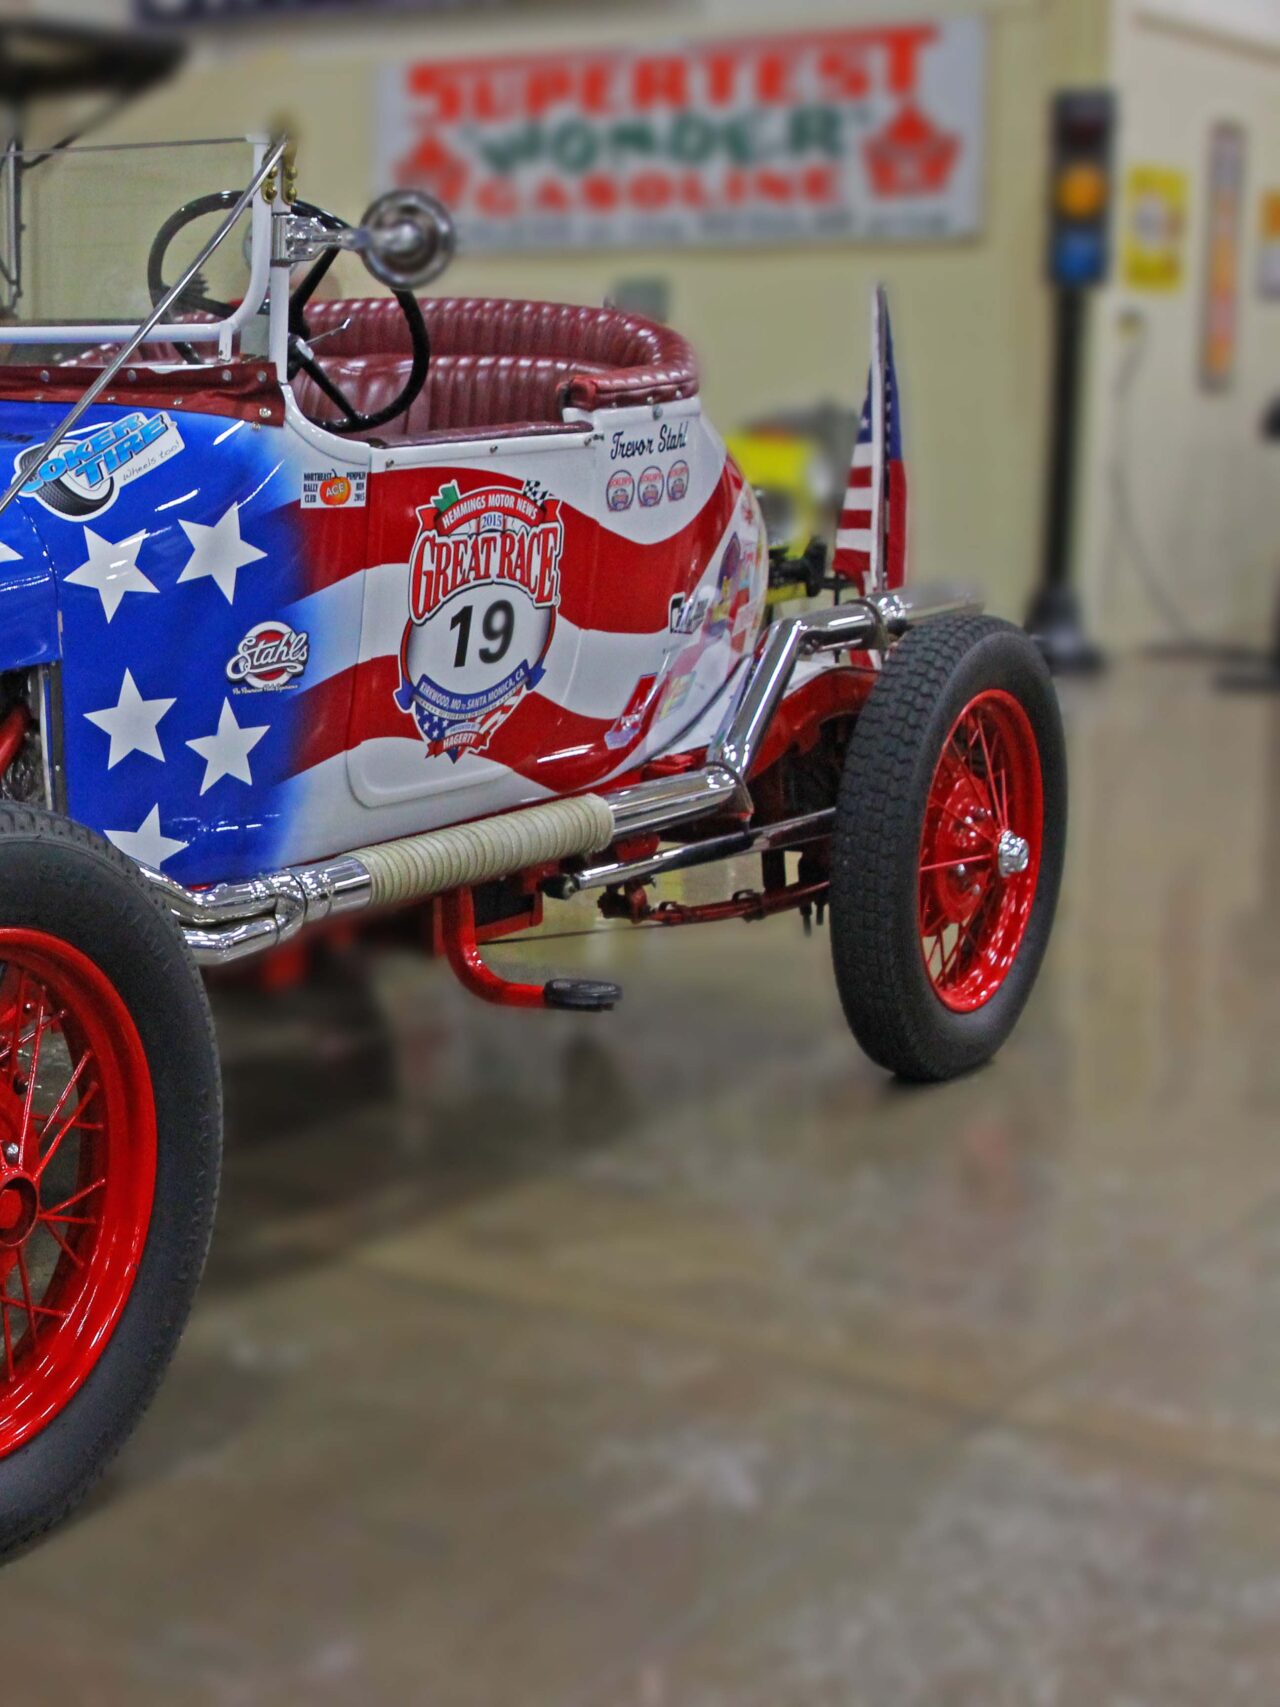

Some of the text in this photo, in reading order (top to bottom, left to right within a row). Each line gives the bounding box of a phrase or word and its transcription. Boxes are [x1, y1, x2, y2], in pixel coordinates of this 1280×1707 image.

[408, 24, 939, 123] SUPERTEST
[474, 164, 842, 217] GASOLINE
[74, 414, 169, 488] TIRE
[610, 421, 689, 460] Trevor Stahl
[325, 482, 346, 498] ACE
[442, 494, 538, 529] HEMMINGS MOTOR NEWS
[481, 513, 502, 528] 2015
[412, 527, 558, 620] GREAT RACE
[449, 599, 515, 668] 19
[420, 681, 450, 710] KIRKWOOD,
[451, 699, 461, 710] MO
[467, 696, 487, 710] SANTA
[487, 678, 516, 701] MONICA,
[516, 668, 525, 681] CA
[443, 733, 478, 749] HAGERTY
